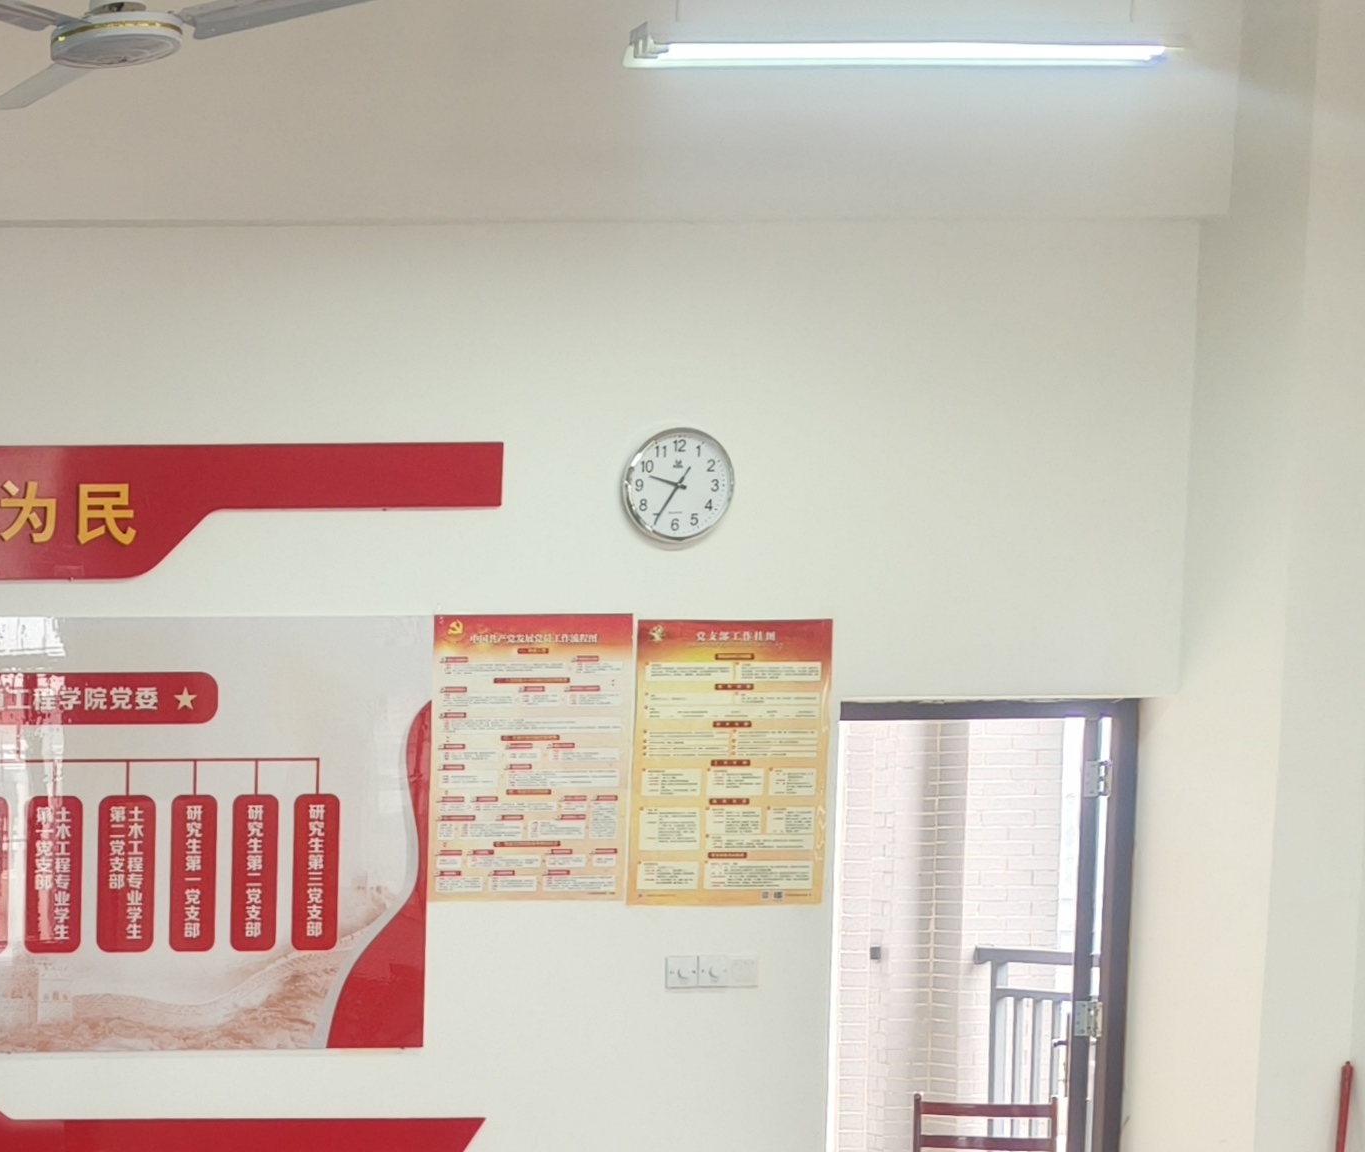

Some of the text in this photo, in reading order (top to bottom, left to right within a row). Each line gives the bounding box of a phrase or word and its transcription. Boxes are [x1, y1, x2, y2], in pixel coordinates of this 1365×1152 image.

[655, 445, 667, 458] 11
[673, 439, 687, 453] 12
[696, 445, 701, 457] 1
[641, 460, 654, 473] 10
[706, 459, 716, 472] 2
[635, 478, 644, 492] 9
[710, 478, 719, 492] 3
[639, 498, 648, 511] 8
[704, 498, 713, 511] 4
[652, 512, 660, 526] 7
[670, 518, 679, 531] 6
[690, 513, 699, 526] 5
[34, 806, 53, 891] 第一党支部
[108, 806, 126, 890] 第二党支部
[54, 807, 72, 940] 土木工程专业学生
[126, 806, 144, 940] 土木工程专业学生
[184, 805, 203, 939] 研究生第一党支部
[245, 805, 264, 938] 研究生第二党支部
[306, 804, 325, 938] 研究生第三党支部
